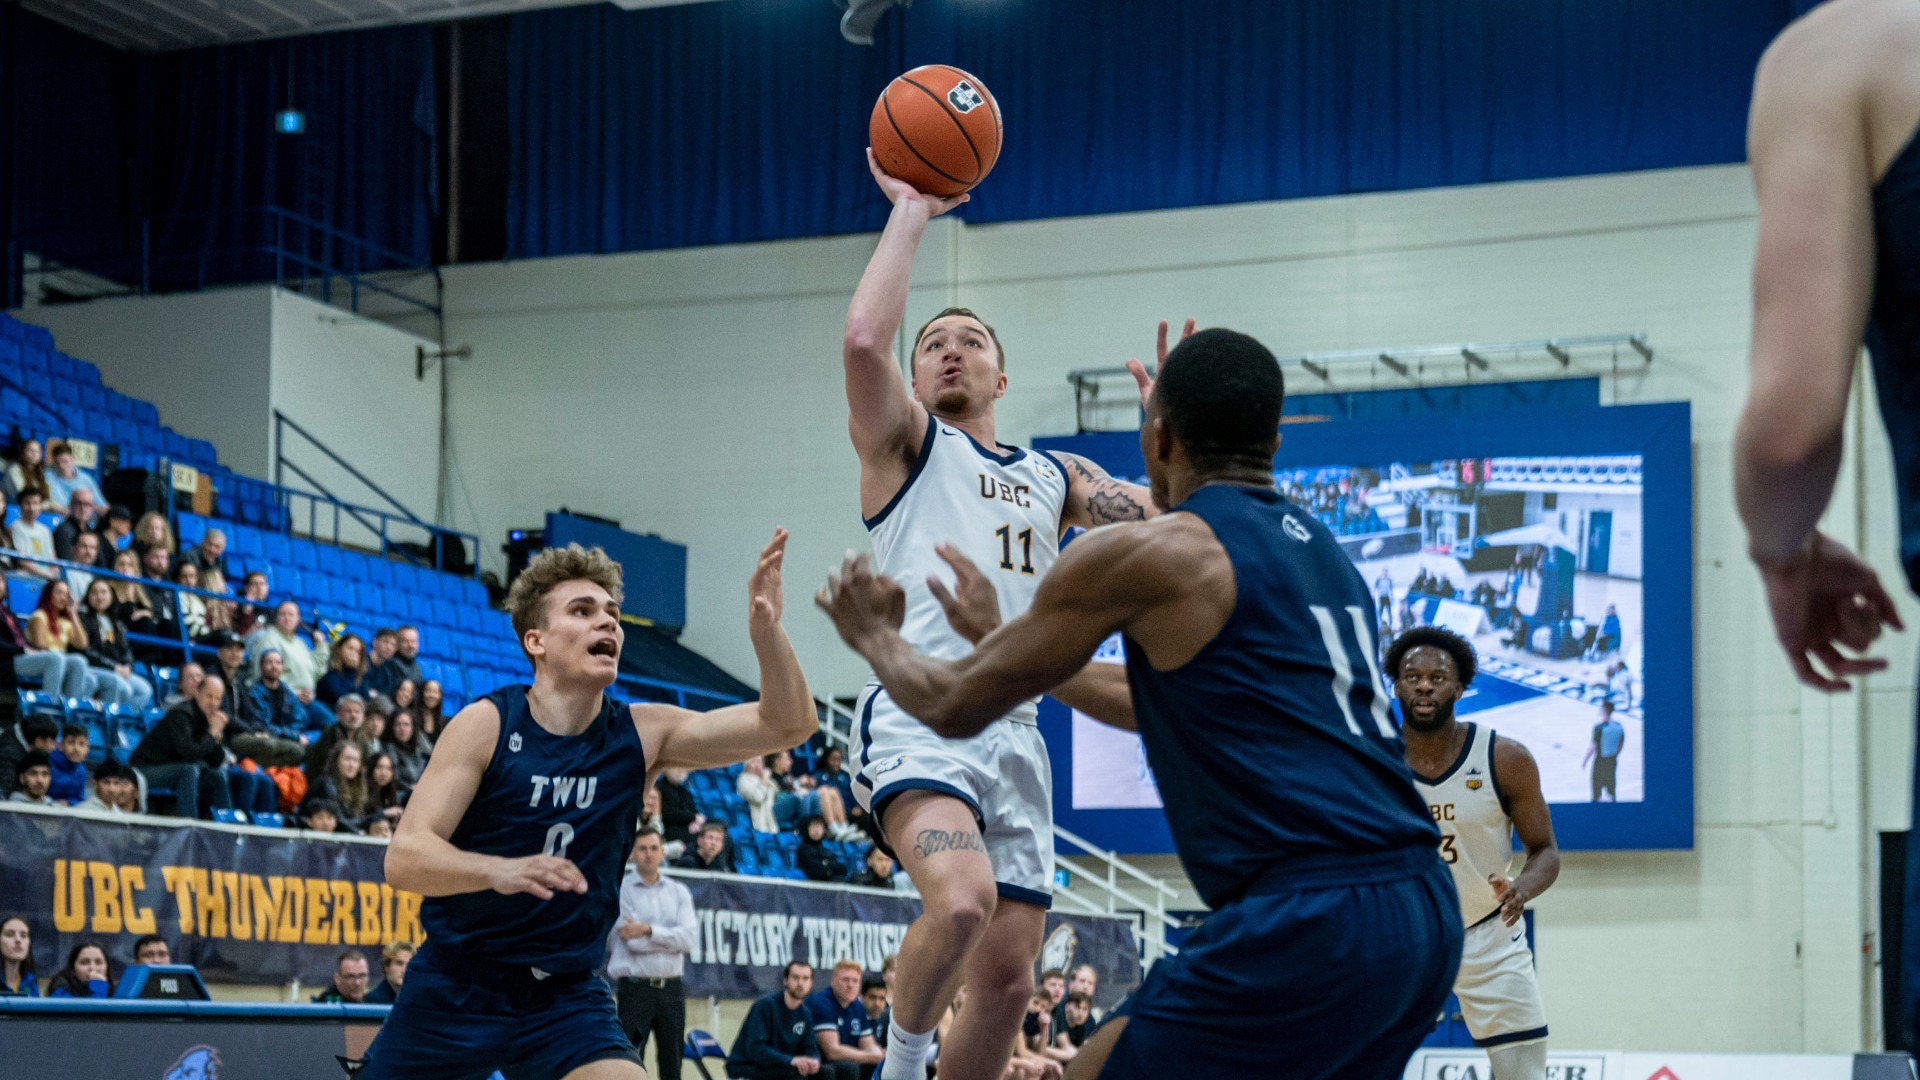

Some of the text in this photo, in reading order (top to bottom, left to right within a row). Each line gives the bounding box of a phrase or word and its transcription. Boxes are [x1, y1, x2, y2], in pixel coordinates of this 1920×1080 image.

[979, 474, 1031, 508] UBC
[995, 522, 1035, 575] 11
[1308, 604, 1399, 739] 11
[529, 774, 598, 809] TWU
[1428, 804, 1456, 821] BC
[1440, 834, 1459, 864] 3
[53, 859, 427, 948] UBC THUNDERBIR
[1437, 1063, 1588, 1080] CAER
